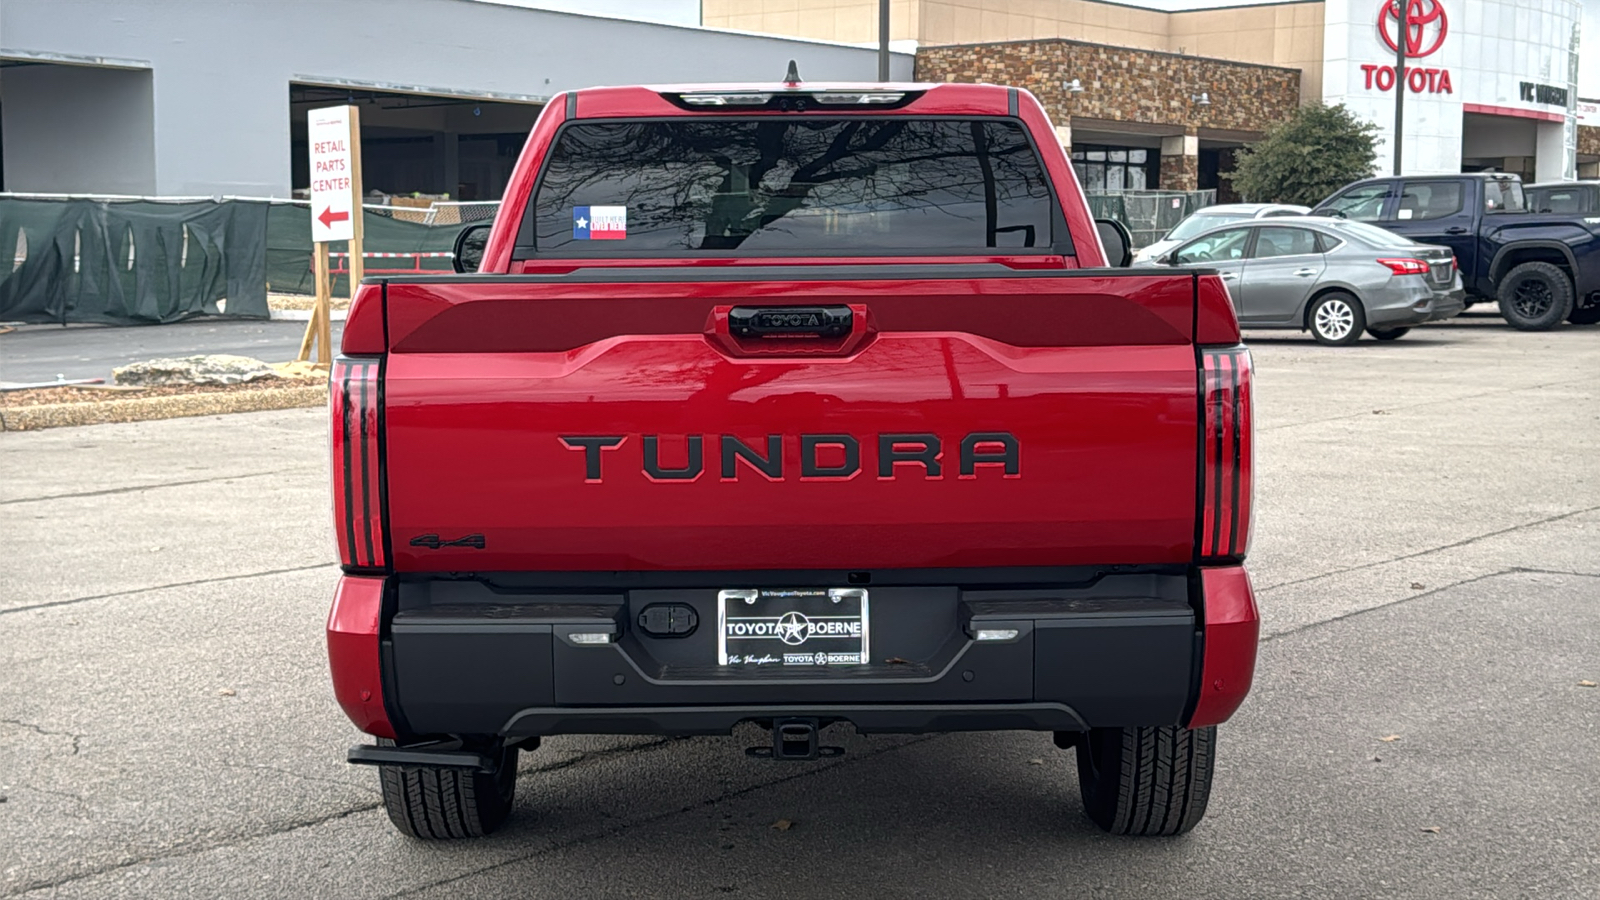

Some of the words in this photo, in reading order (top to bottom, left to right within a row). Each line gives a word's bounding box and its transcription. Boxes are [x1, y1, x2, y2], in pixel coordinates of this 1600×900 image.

[314, 140, 346, 154] RETAIL
[316, 159, 345, 173] PARTS
[312, 178, 350, 192] CENTER
[762, 314, 820, 326] TOYOTA
[557, 432, 1022, 484] TUNDRA
[727, 623, 785, 635] TOYOTA
[808, 622, 862, 634] BOERNE
[783, 655, 814, 663] TOYOTA
[827, 655, 860, 663] BOERNE
